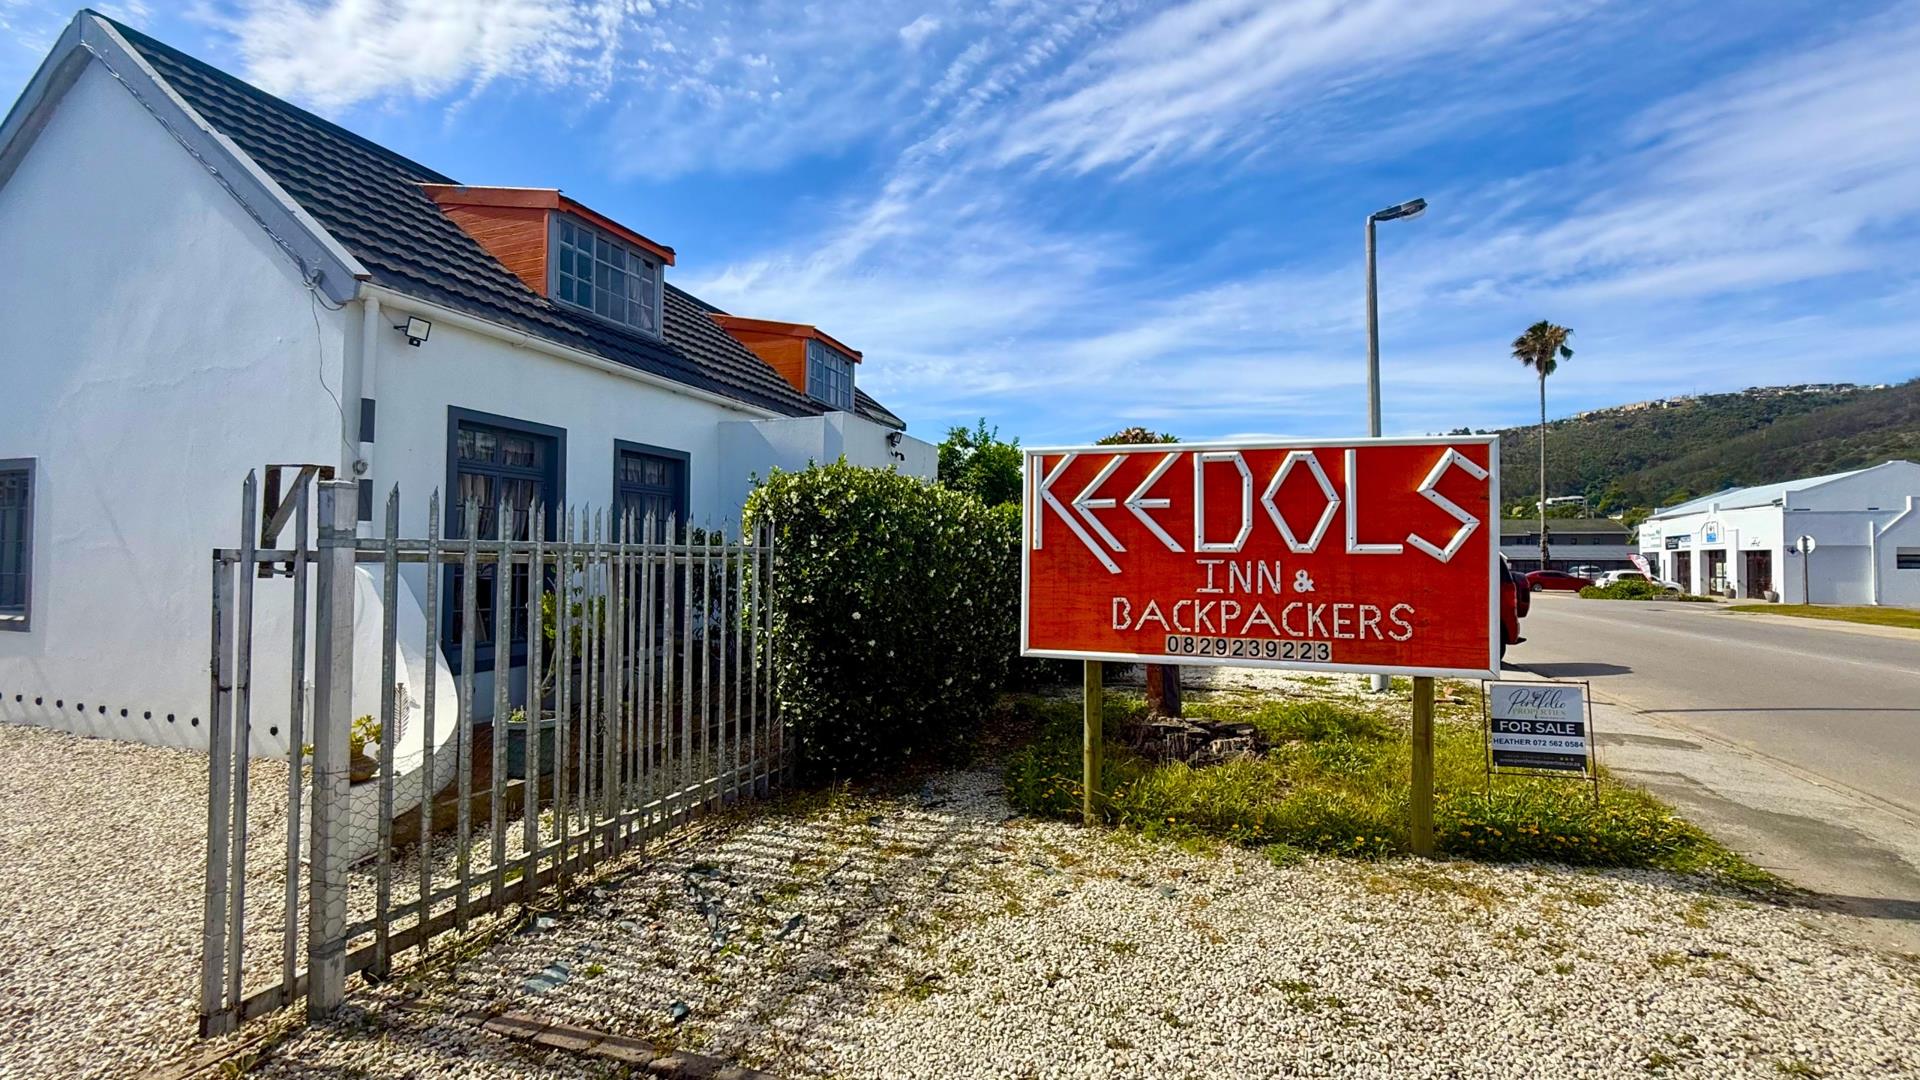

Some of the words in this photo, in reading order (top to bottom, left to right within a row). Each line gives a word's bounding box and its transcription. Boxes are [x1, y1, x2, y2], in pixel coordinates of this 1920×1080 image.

[1033, 447, 1489, 574] KEEDOLS
[1196, 559, 1281, 594] INN
[1293, 569, 1315, 593] &
[1111, 596, 1415, 641] BACKPACKERS
[1167, 635, 1330, 660] 0829239223
[1508, 688, 1566, 714] Portfolio
[1513, 707, 1567, 716] PROPERTIES
[1500, 721, 1531, 733] FOR
[1536, 722, 1575, 735] SALE
[1493, 738, 1531, 746] HEATHER
[1533, 739, 1547, 747] 072
[1565, 740, 1584, 748] 0584
